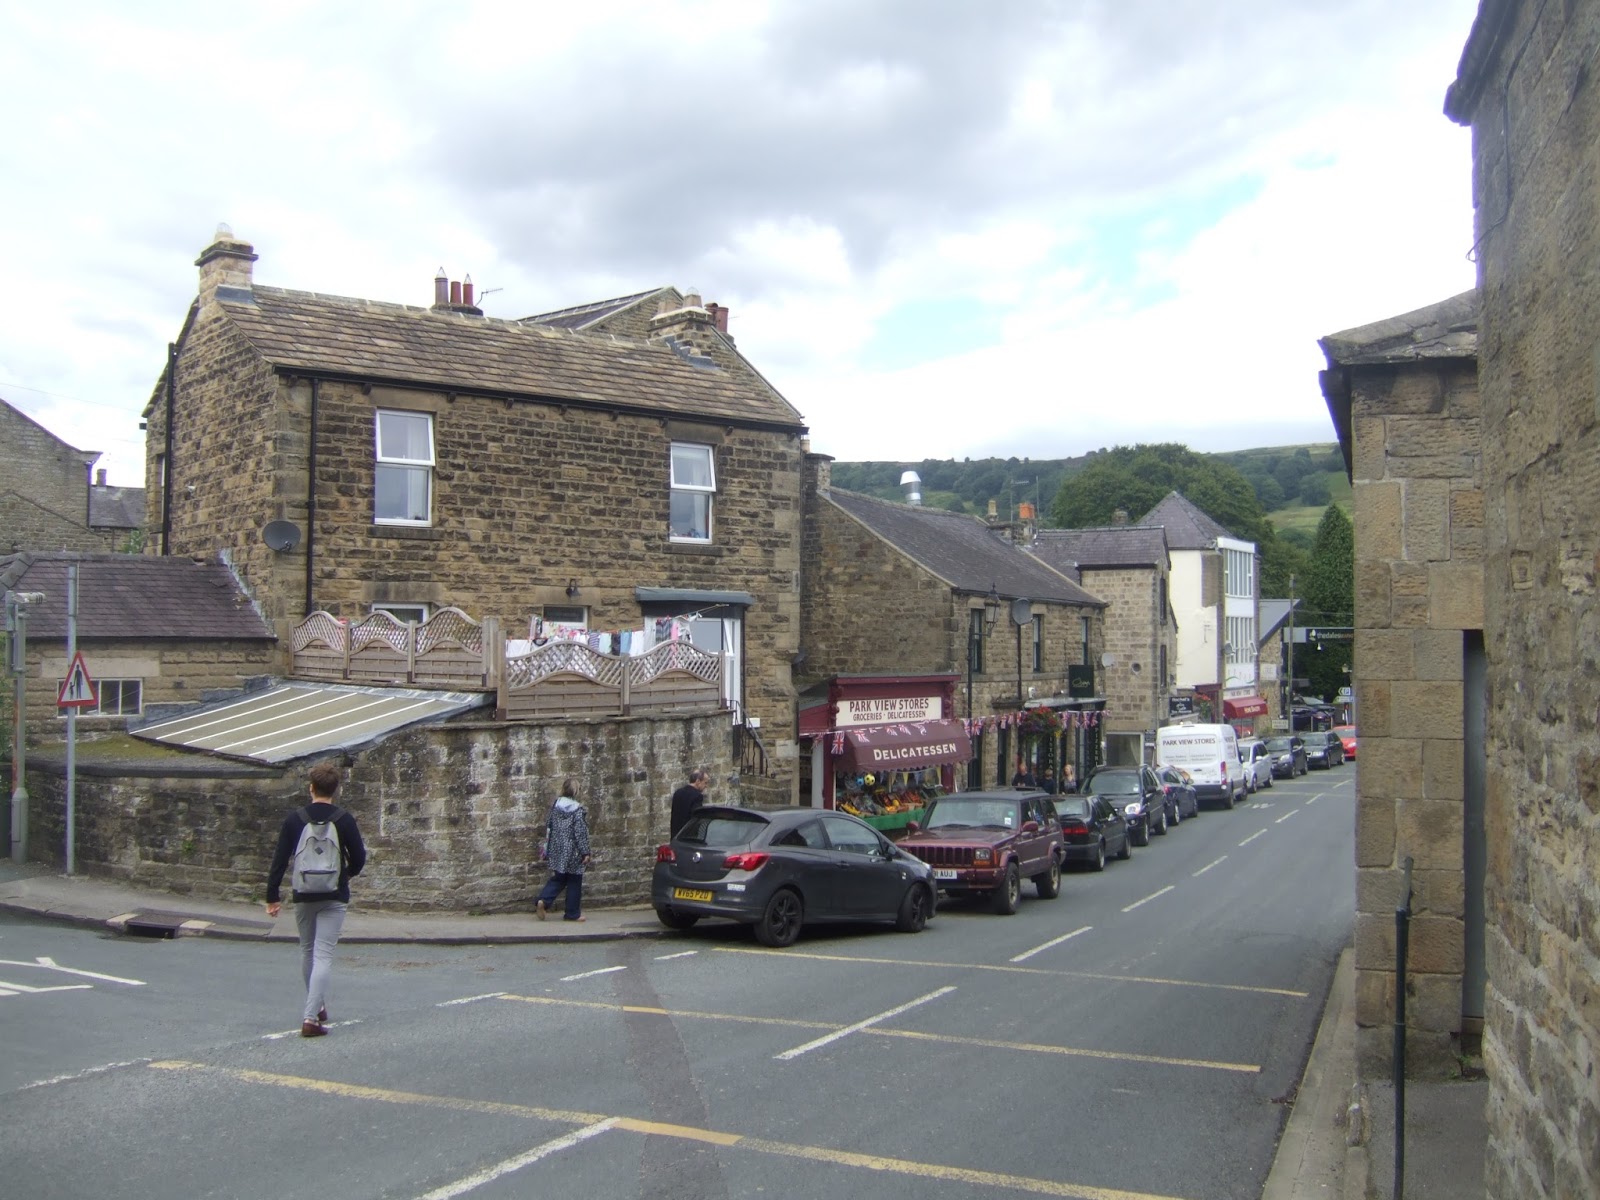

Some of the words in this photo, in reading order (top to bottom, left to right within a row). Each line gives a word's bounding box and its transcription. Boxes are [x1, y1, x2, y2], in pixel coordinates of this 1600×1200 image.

[849, 701, 872, 713] PARK
[875, 699, 898, 711] VIEW
[899, 698, 929, 710] STORES
[853, 712, 882, 721] GROCERIES
[887, 710, 926, 720] DELICATESSEN
[1194, 737, 1216, 745] STORES
[873, 743, 957, 761] DELICATESSEN
